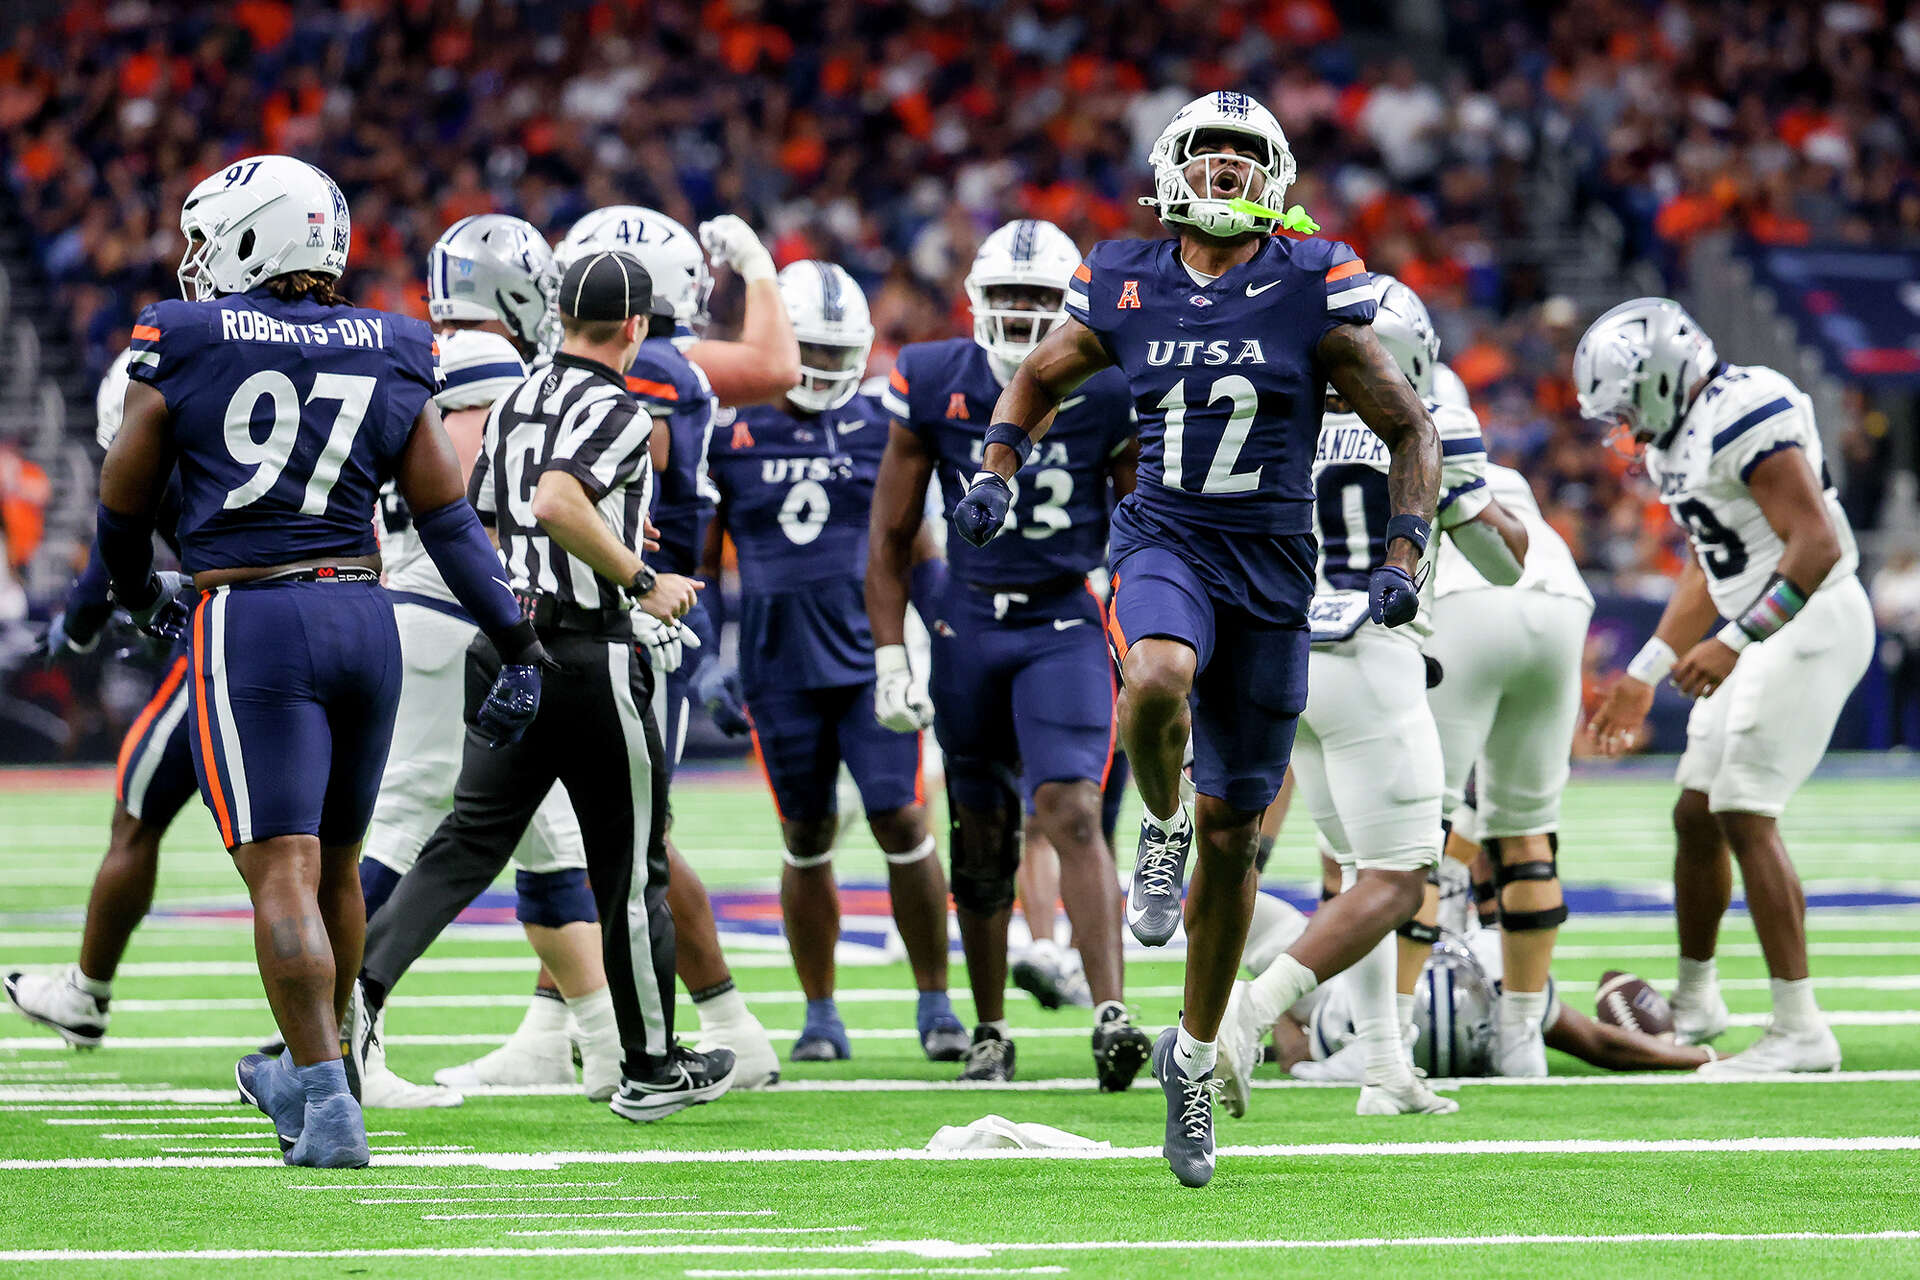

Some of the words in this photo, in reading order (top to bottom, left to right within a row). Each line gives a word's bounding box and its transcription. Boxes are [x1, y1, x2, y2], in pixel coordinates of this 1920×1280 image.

[225, 161, 263, 188] 97
[616, 219, 649, 244] 42
[1117, 281, 1141, 309] A
[220, 309, 385, 349] ROBERTS-DAY
[1146, 339, 1267, 367] UTSA
[223, 369, 378, 517] 97
[1156, 374, 1264, 494] 12
[777, 479, 831, 546] 0
